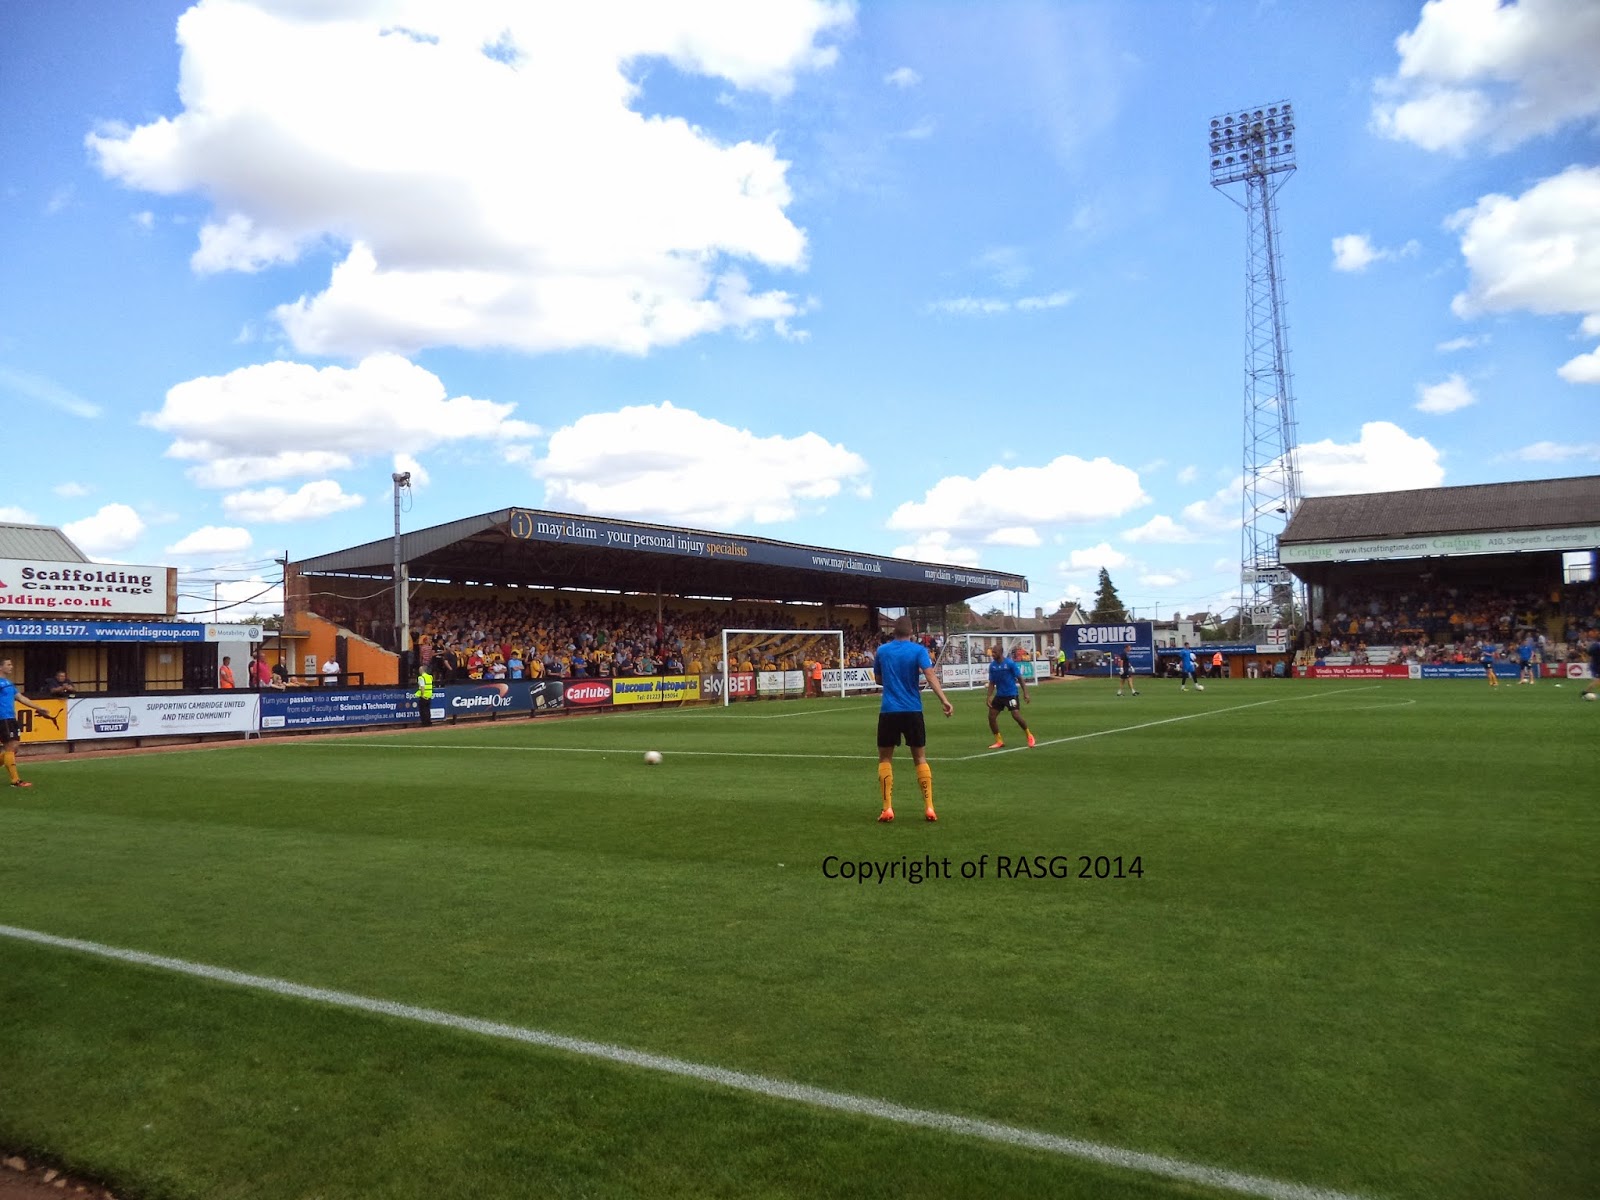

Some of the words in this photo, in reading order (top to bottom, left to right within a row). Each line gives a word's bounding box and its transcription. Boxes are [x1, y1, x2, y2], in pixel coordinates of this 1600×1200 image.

[537, 520, 597, 540] mayiclaim
[606, 529, 631, 545] your
[633, 532, 675, 549] personal
[677, 536, 705, 554] injury
[706, 541, 748, 557] specialists
[1545, 533, 1587, 544] Cambridge
[812, 556, 882, 573] www.mayiclaim.co.uk
[21, 567, 153, 587] Scaffolding
[21, 582, 153, 595] Cambridge
[1253, 606, 1271, 615] CAT
[7, 624, 42, 635] 01223
[45, 625, 89, 636] 581577.
[95, 625, 200, 640] www.vindisgroup.com
[1077, 625, 1137, 644] sepura
[822, 671, 836, 682] MICK
[836, 670, 858, 682] GORGE
[703, 675, 725, 696] sky
[729, 676, 753, 692] BET
[289, 696, 314, 704] passion
[566, 687, 611, 700] Carlube
[146, 702, 188, 711] SUPPORTING
[188, 701, 223, 710] CAMBRIDGE
[223, 700, 246, 708] UNITED
[340, 703, 362, 711] Science
[366, 702, 397, 710] Technology
[162, 713, 177, 721] AND
[177, 712, 195, 720] THEIR
[195, 711, 232, 720] COMMUNITY
